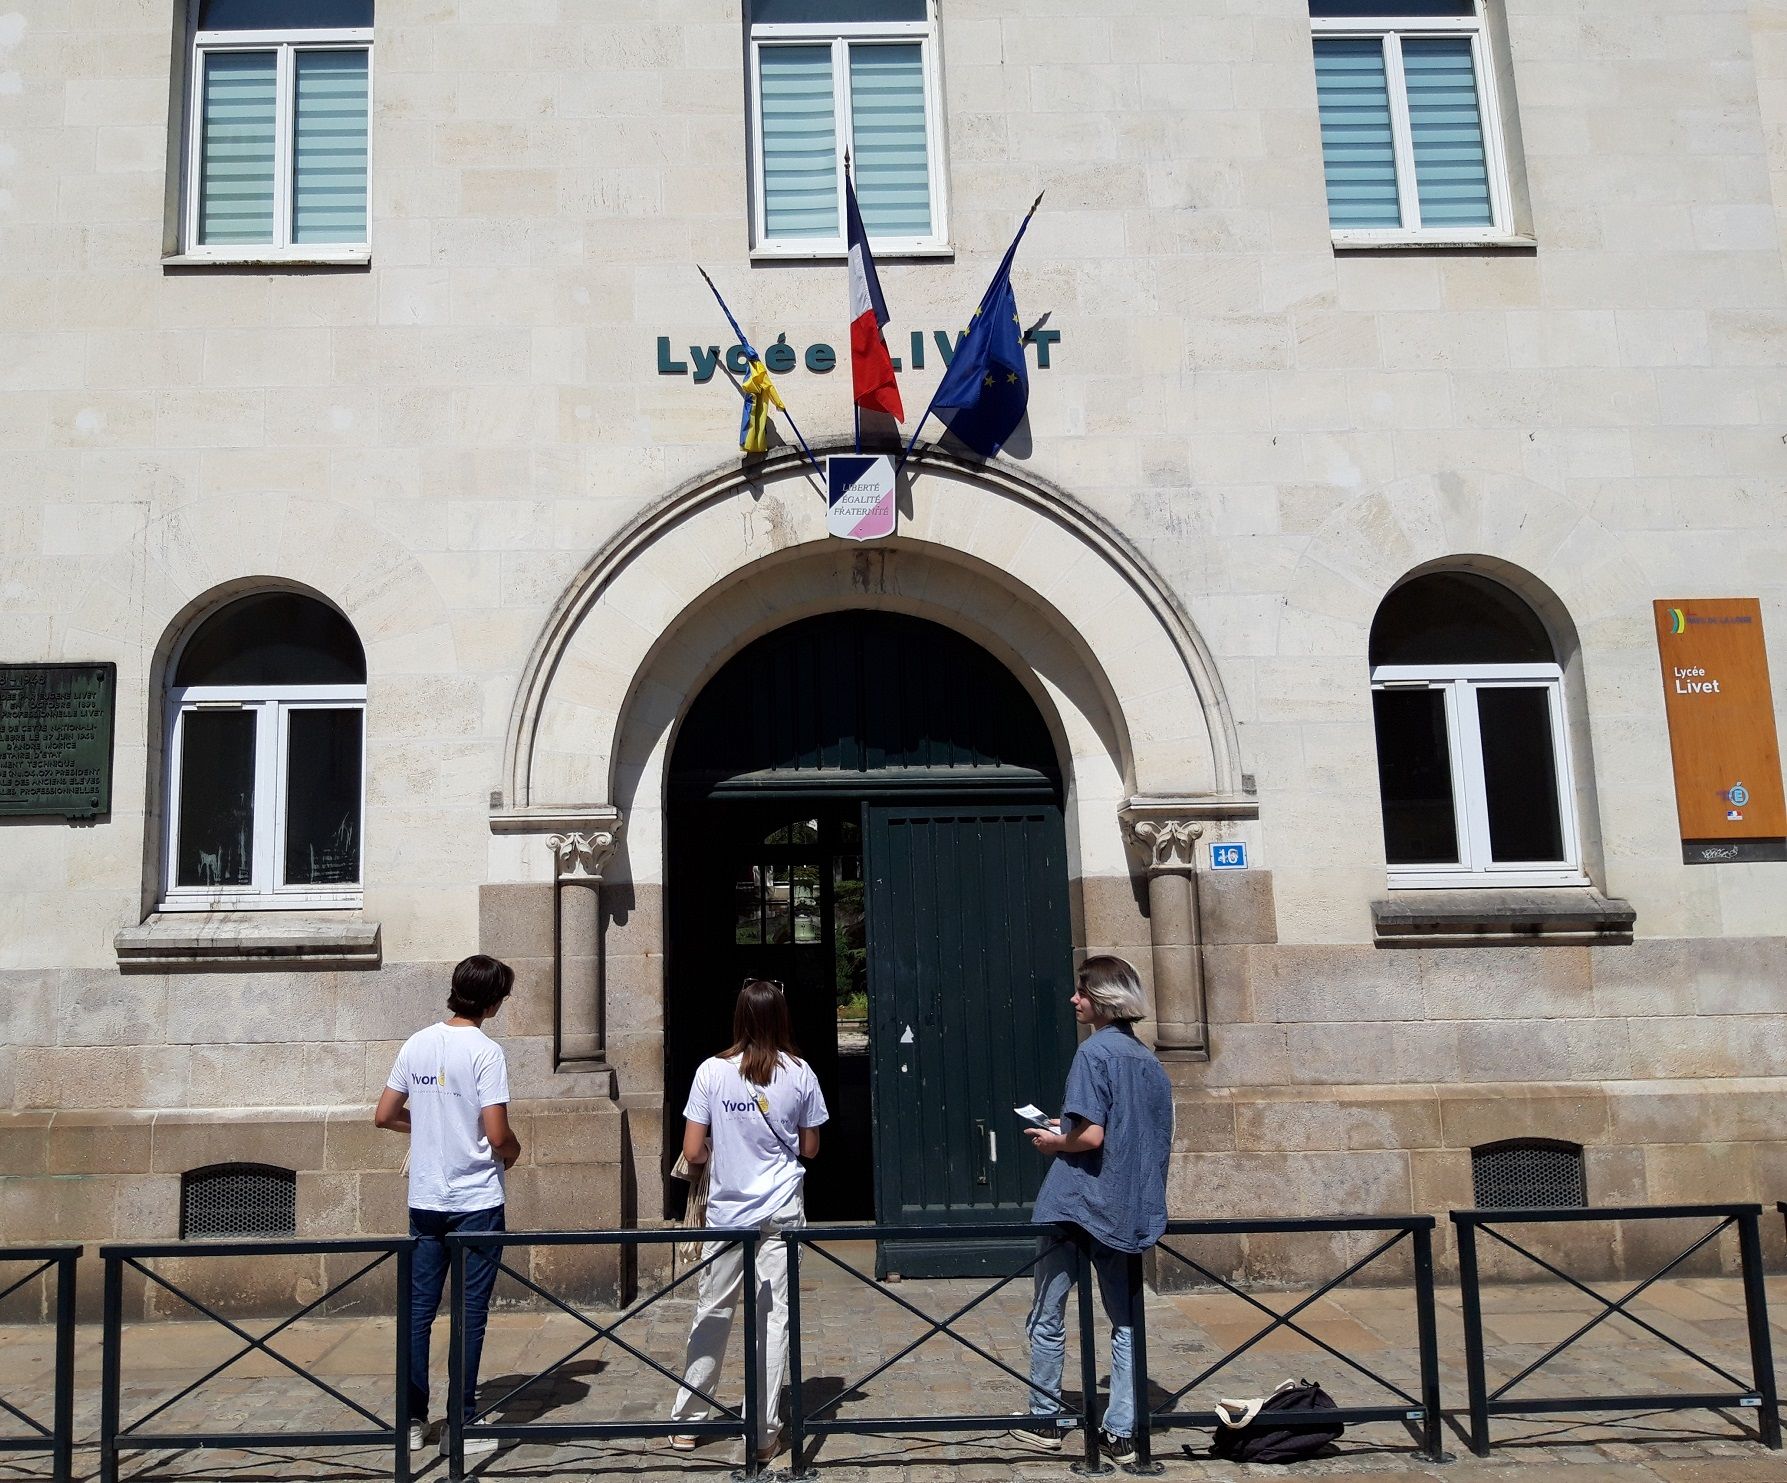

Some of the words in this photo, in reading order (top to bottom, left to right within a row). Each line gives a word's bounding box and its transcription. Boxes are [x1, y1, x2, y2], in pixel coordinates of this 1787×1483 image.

[657, 332, 836, 384] Lycée
[891, 329, 1061, 372] IVT
[842, 482, 880, 492] LIBERTÉ
[841, 495, 881, 504] ÉGALITÉ
[833, 507, 889, 516] FRATERNITÉ
[1674, 666, 1706, 679] Lycée
[1675, 679, 1720, 694] Livet
[81, 710, 104, 718] LIVET
[27, 760, 75, 769] TECHNIQUE
[32, 778, 67, 786] ANCIENS
[20, 787, 100, 796] PROFESSIONNELLES
[411, 1072, 438, 1085] Yvon
[722, 1100, 756, 1112] Yvon
